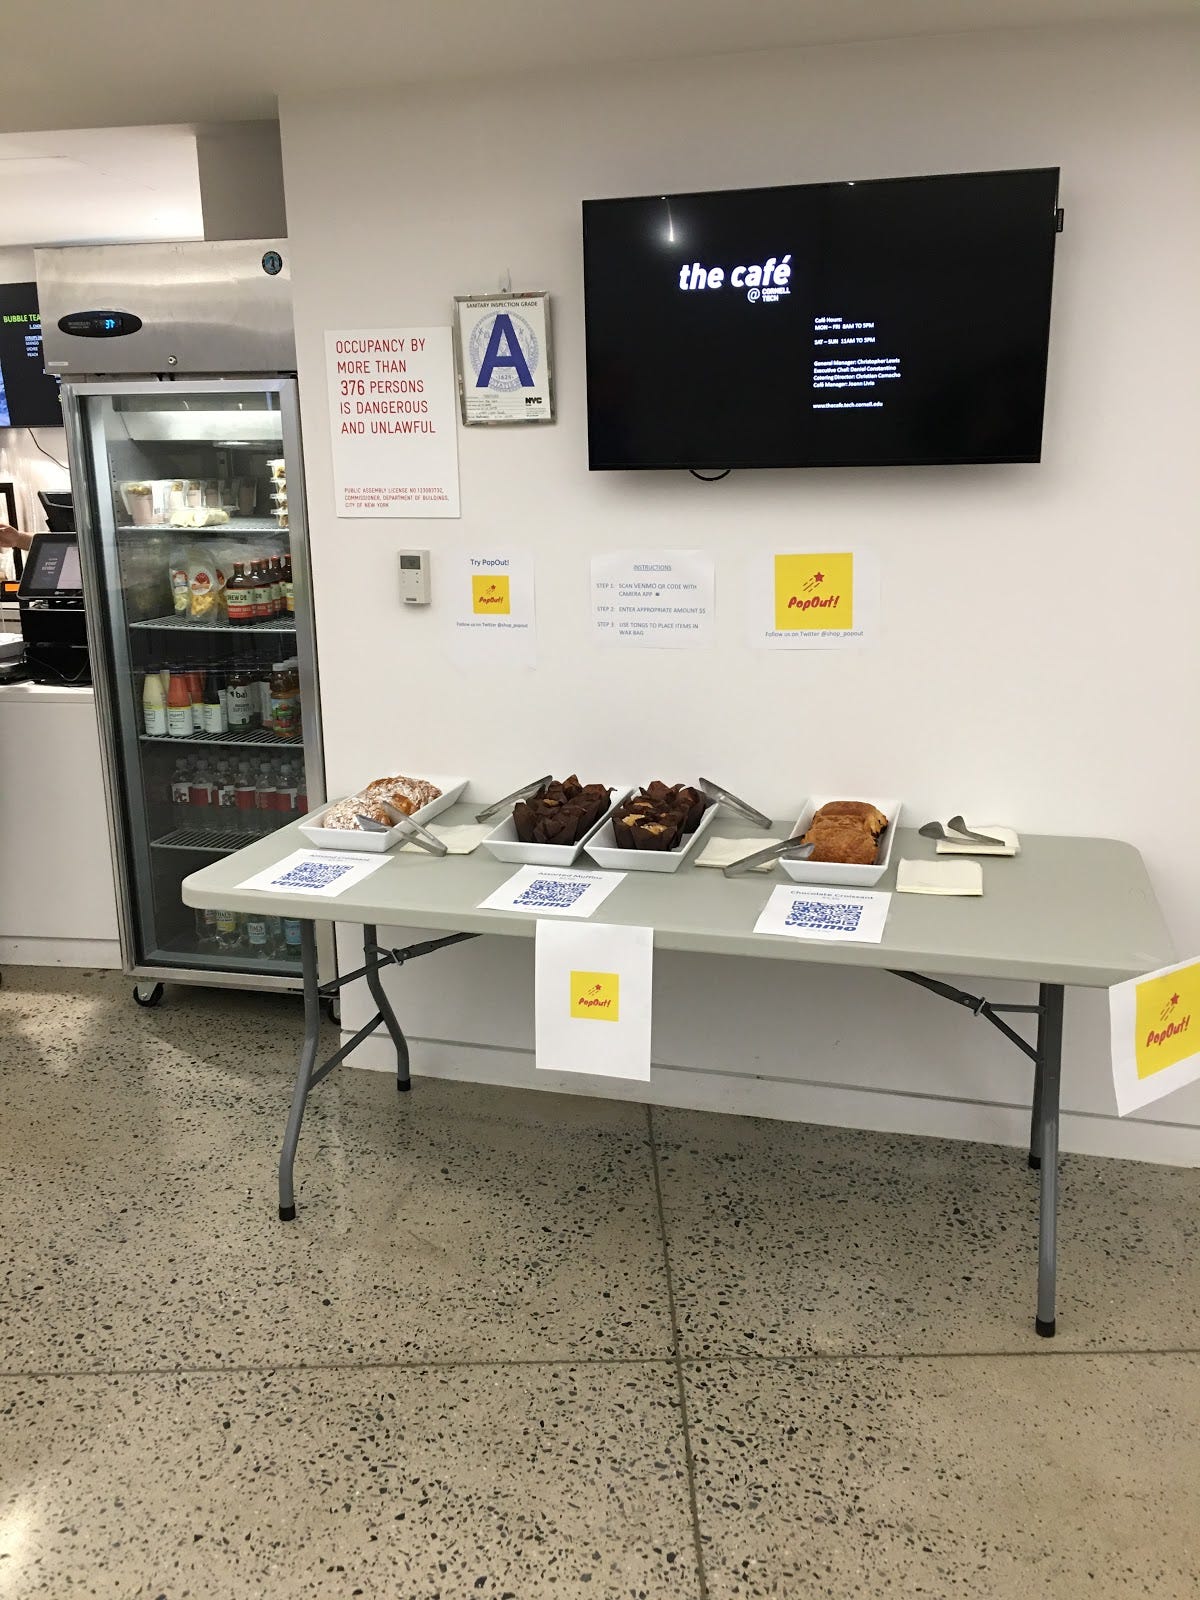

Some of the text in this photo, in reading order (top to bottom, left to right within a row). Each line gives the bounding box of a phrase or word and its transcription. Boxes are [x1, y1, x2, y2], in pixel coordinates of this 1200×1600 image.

[679, 255, 791, 290] the café
[747, 287, 790, 303] @ CORNELL
[762, 294, 779, 302] TECH
[3, 315, 28, 323] BUBBLE
[336, 338, 425, 353] OCCUPANCY BY
[476, 314, 535, 387] A
[337, 360, 406, 374] MORE THAN
[340, 380, 424, 396] 376 PERSONS
[340, 400, 428, 415] IS DANGEROUS
[341, 421, 436, 434] AND UNLAWFUL
[470, 559, 480, 567] Try
[479, 596, 503, 604] PopOut!
[788, 595, 840, 611] PopOut!
[270, 880, 325, 889] venmo
[513, 900, 572, 908] venmo
[785, 920, 857, 932] venmo
[578, 997, 611, 1008] PopOut!
[1146, 1015, 1191, 1047] PopOut!
